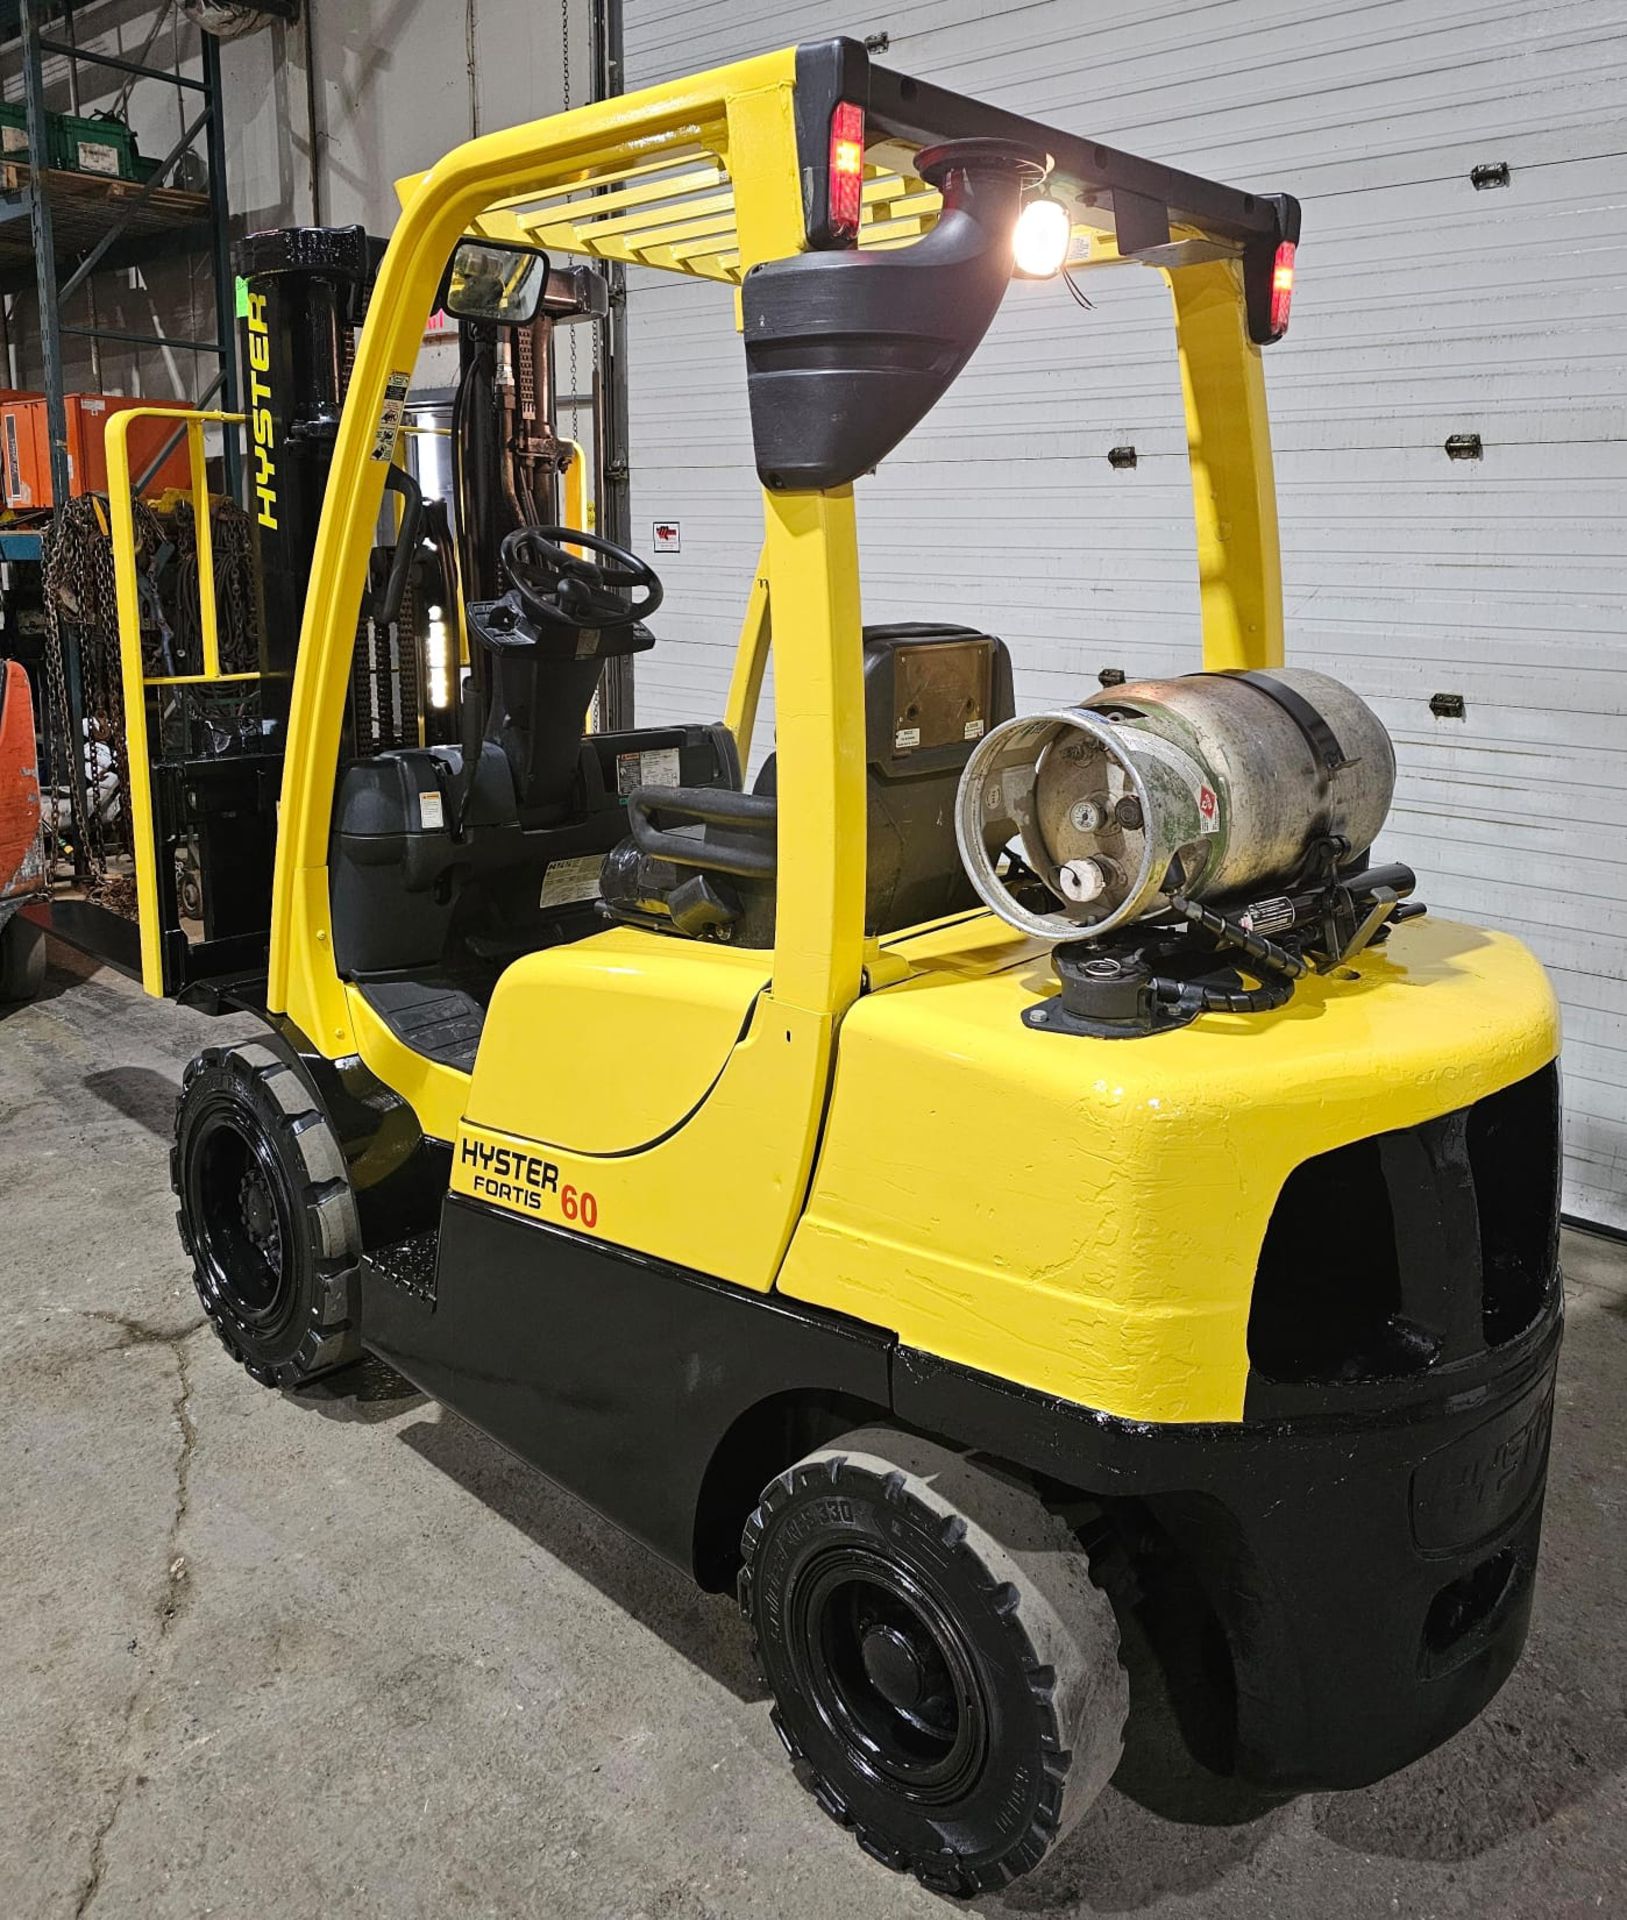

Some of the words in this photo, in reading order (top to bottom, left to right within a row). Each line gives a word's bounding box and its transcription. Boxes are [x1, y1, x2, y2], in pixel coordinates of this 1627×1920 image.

[248, 293, 278, 530] HYSTER
[461, 1138, 559, 1193] HYSTER
[474, 1175, 542, 1210] FORTIS
[561, 1184, 598, 1229] 60
